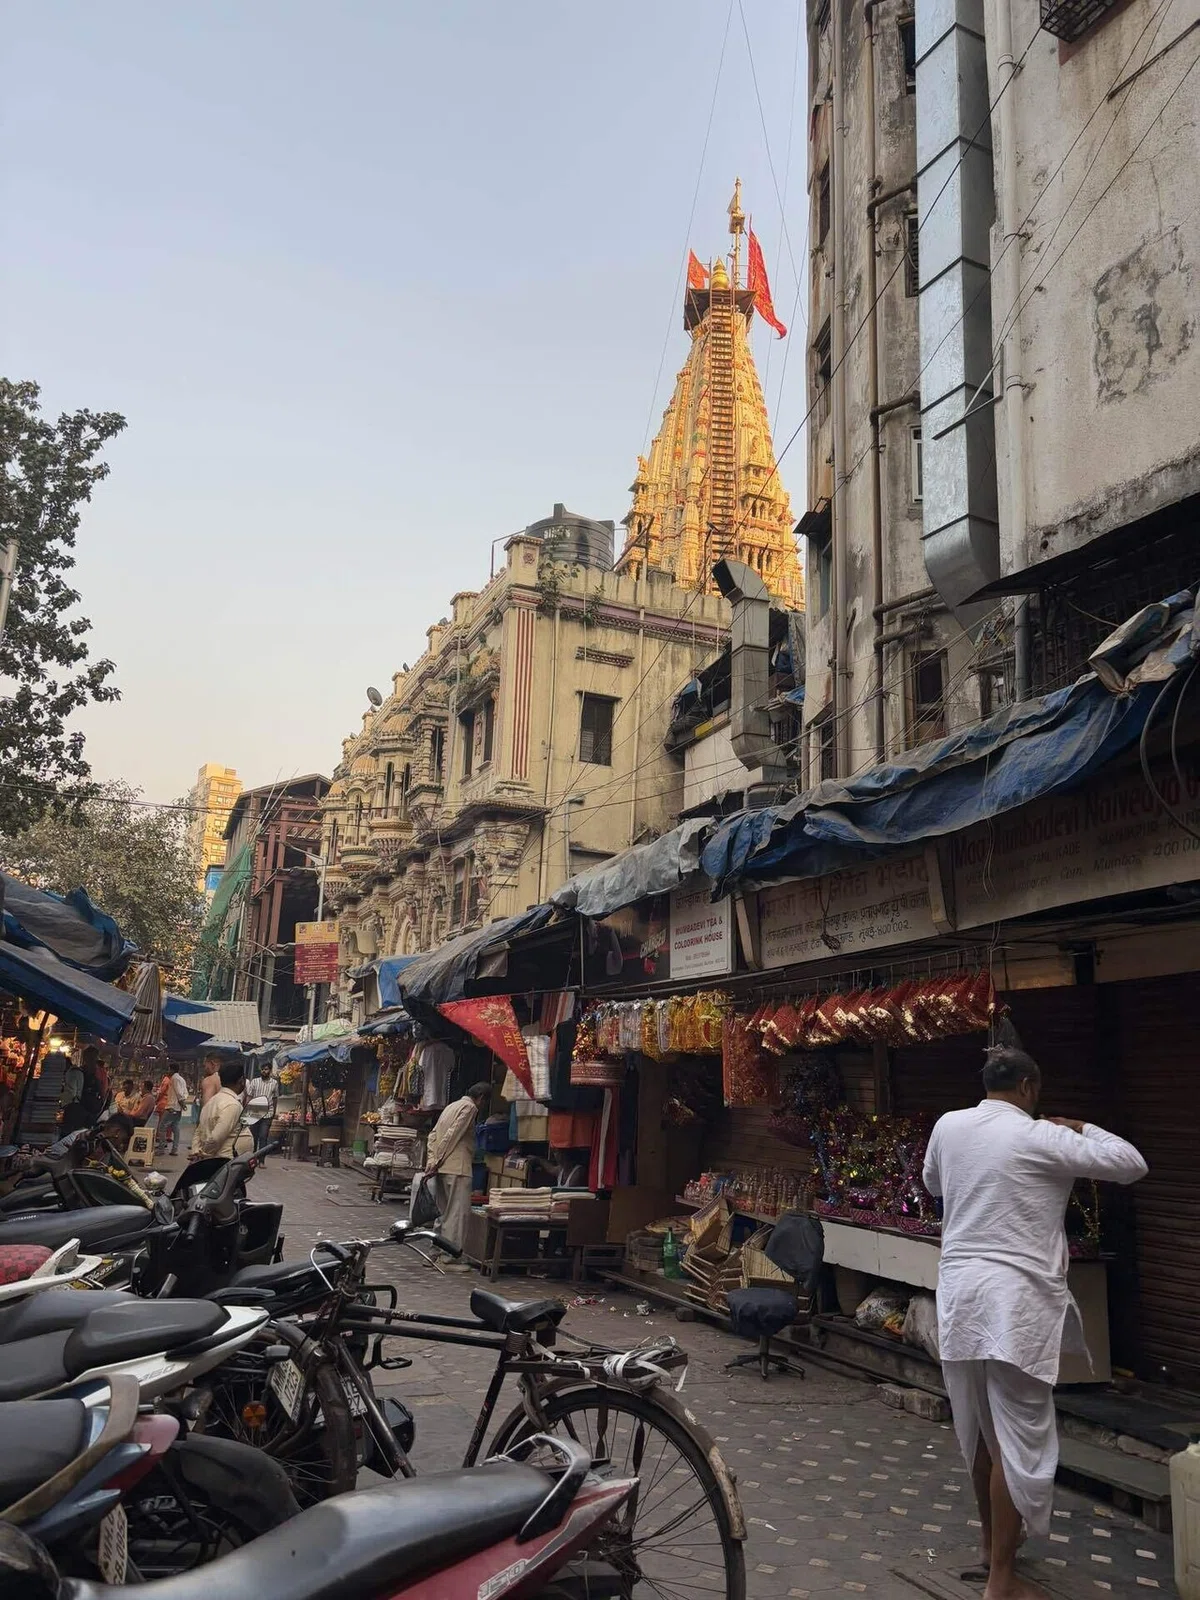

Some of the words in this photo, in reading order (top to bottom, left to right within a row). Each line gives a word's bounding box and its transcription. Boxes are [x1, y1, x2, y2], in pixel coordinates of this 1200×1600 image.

[706, 917, 718, 929] TEA
[718, 915, 723, 925] &
[704, 931, 723, 943] HOUSE
